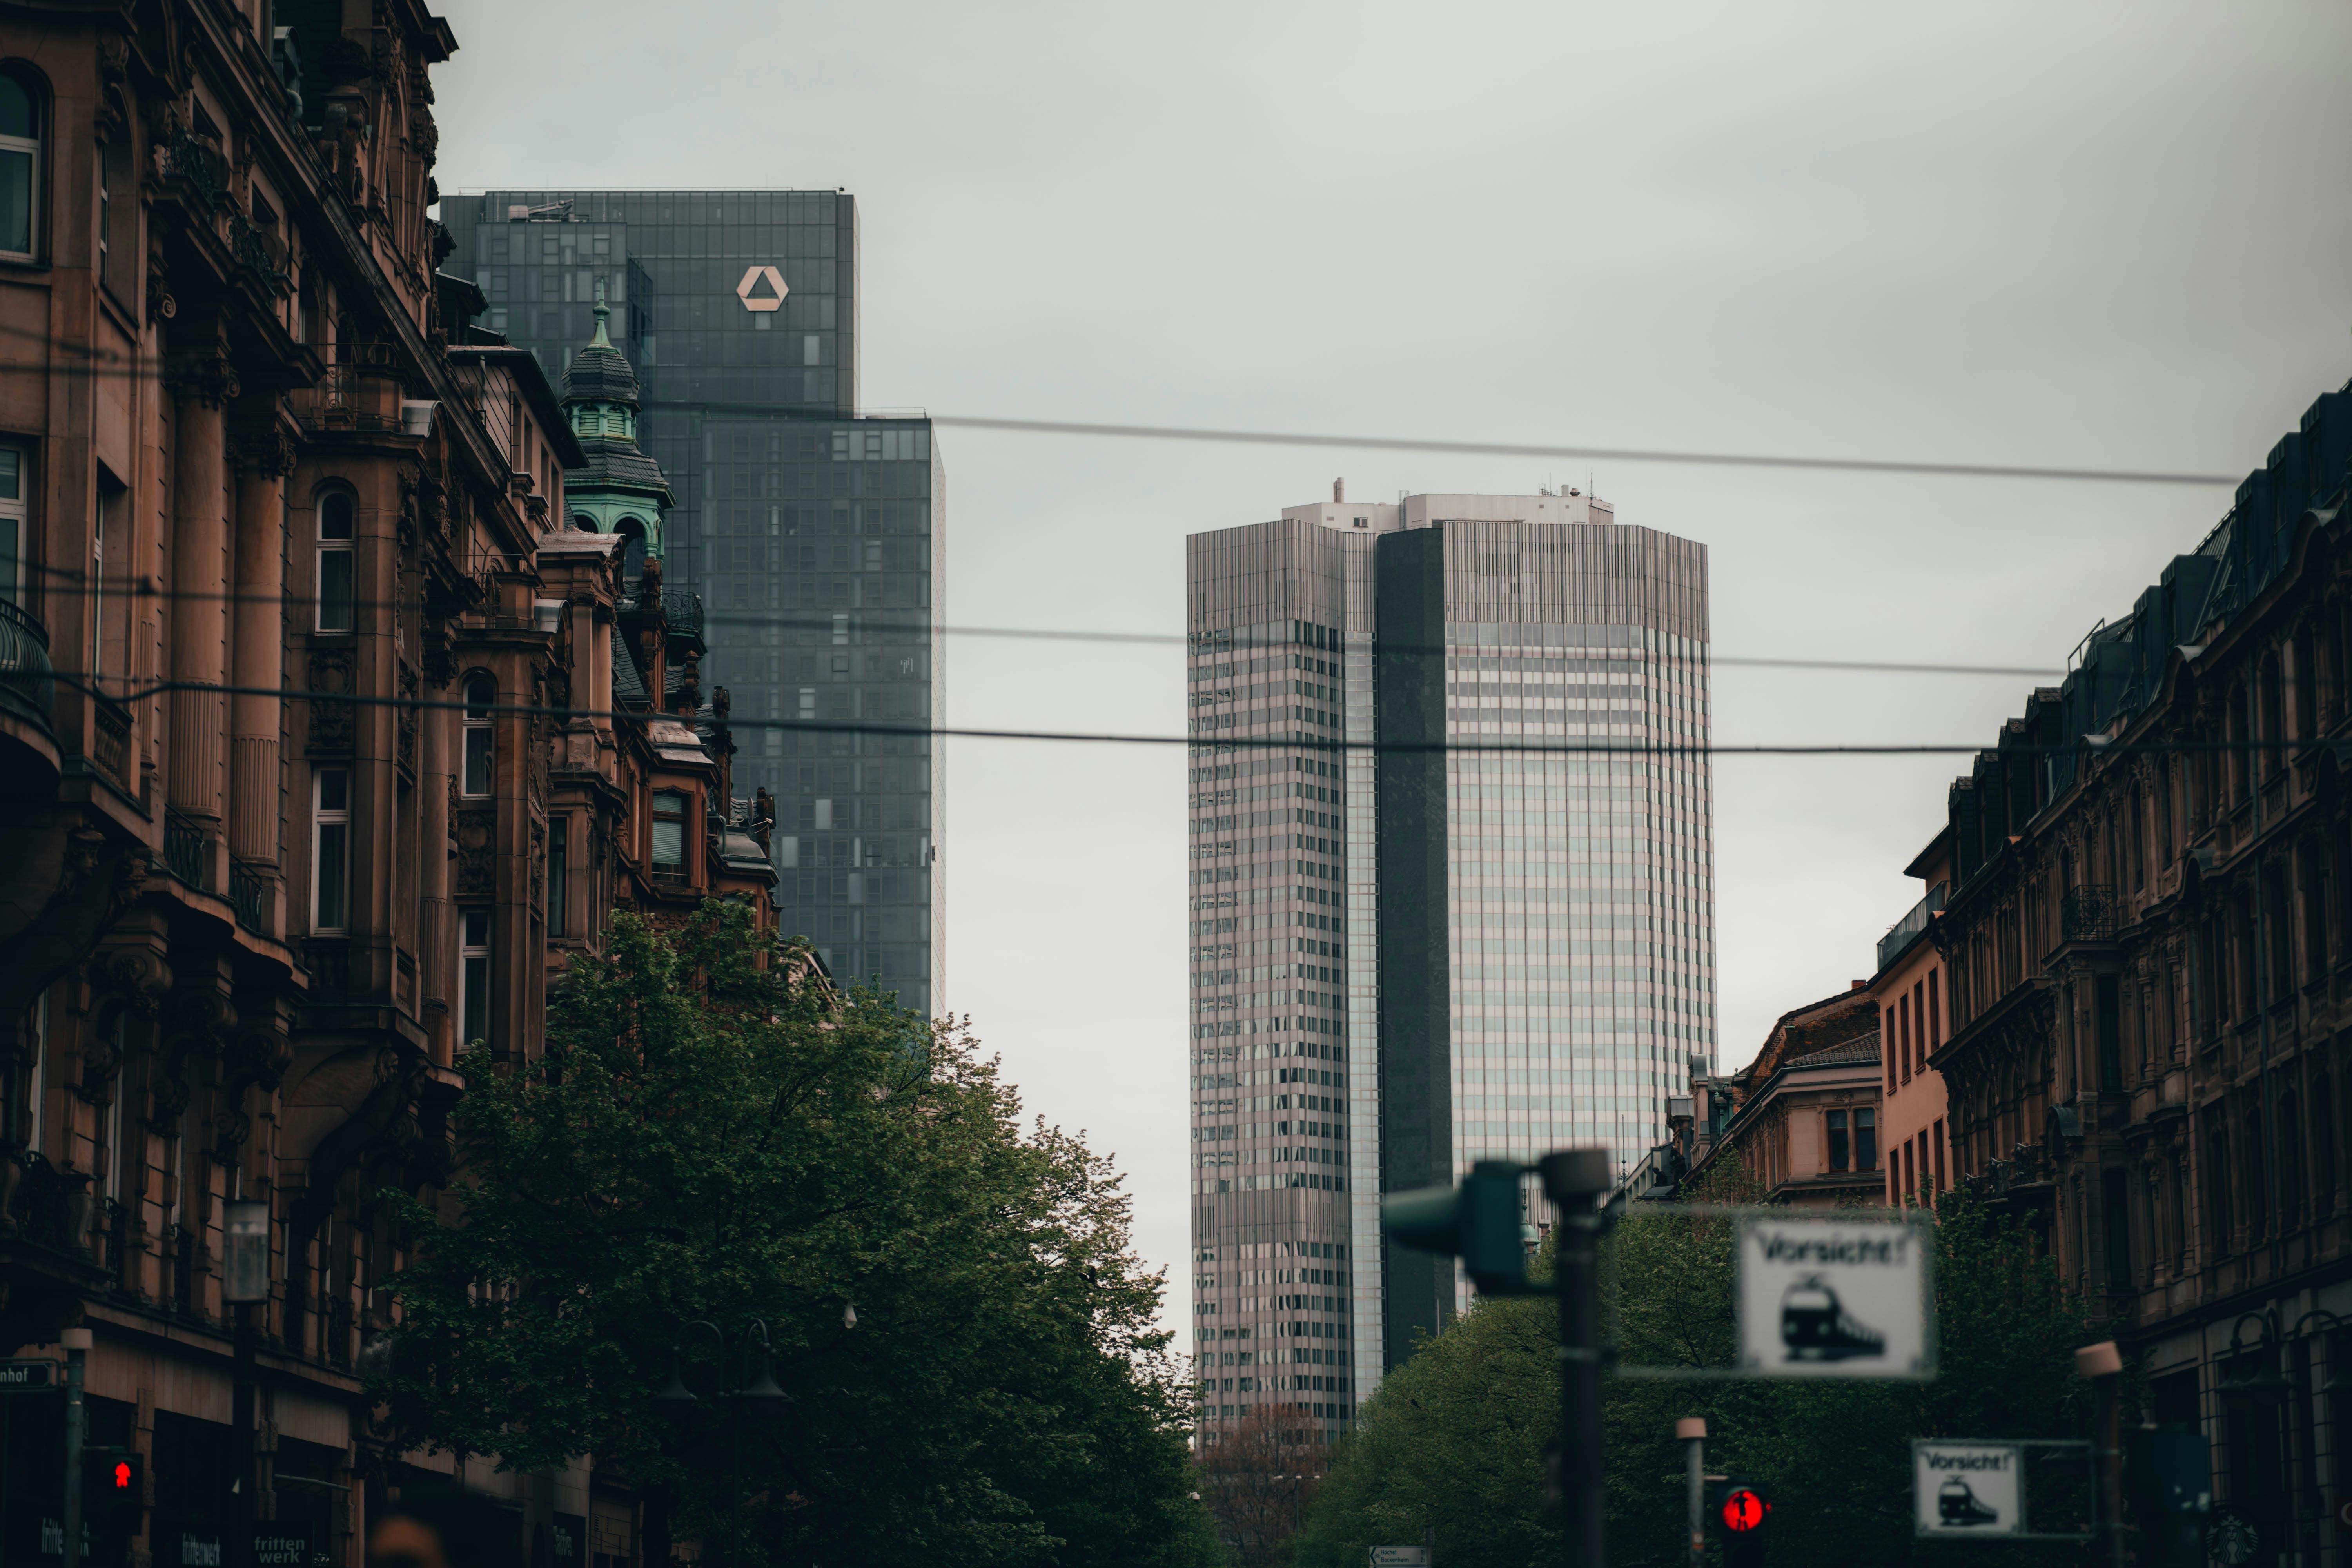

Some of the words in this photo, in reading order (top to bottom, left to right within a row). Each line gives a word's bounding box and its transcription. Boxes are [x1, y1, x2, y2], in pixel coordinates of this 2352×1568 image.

[1760, 1232, 1907, 1265] Vorsicht!
[0, 1367, 29, 1383] nhof
[1926, 1451, 2008, 1470] Vorsicht!
[254, 1536, 305, 1550] fritten
[259, 1547, 300, 1563] werk
